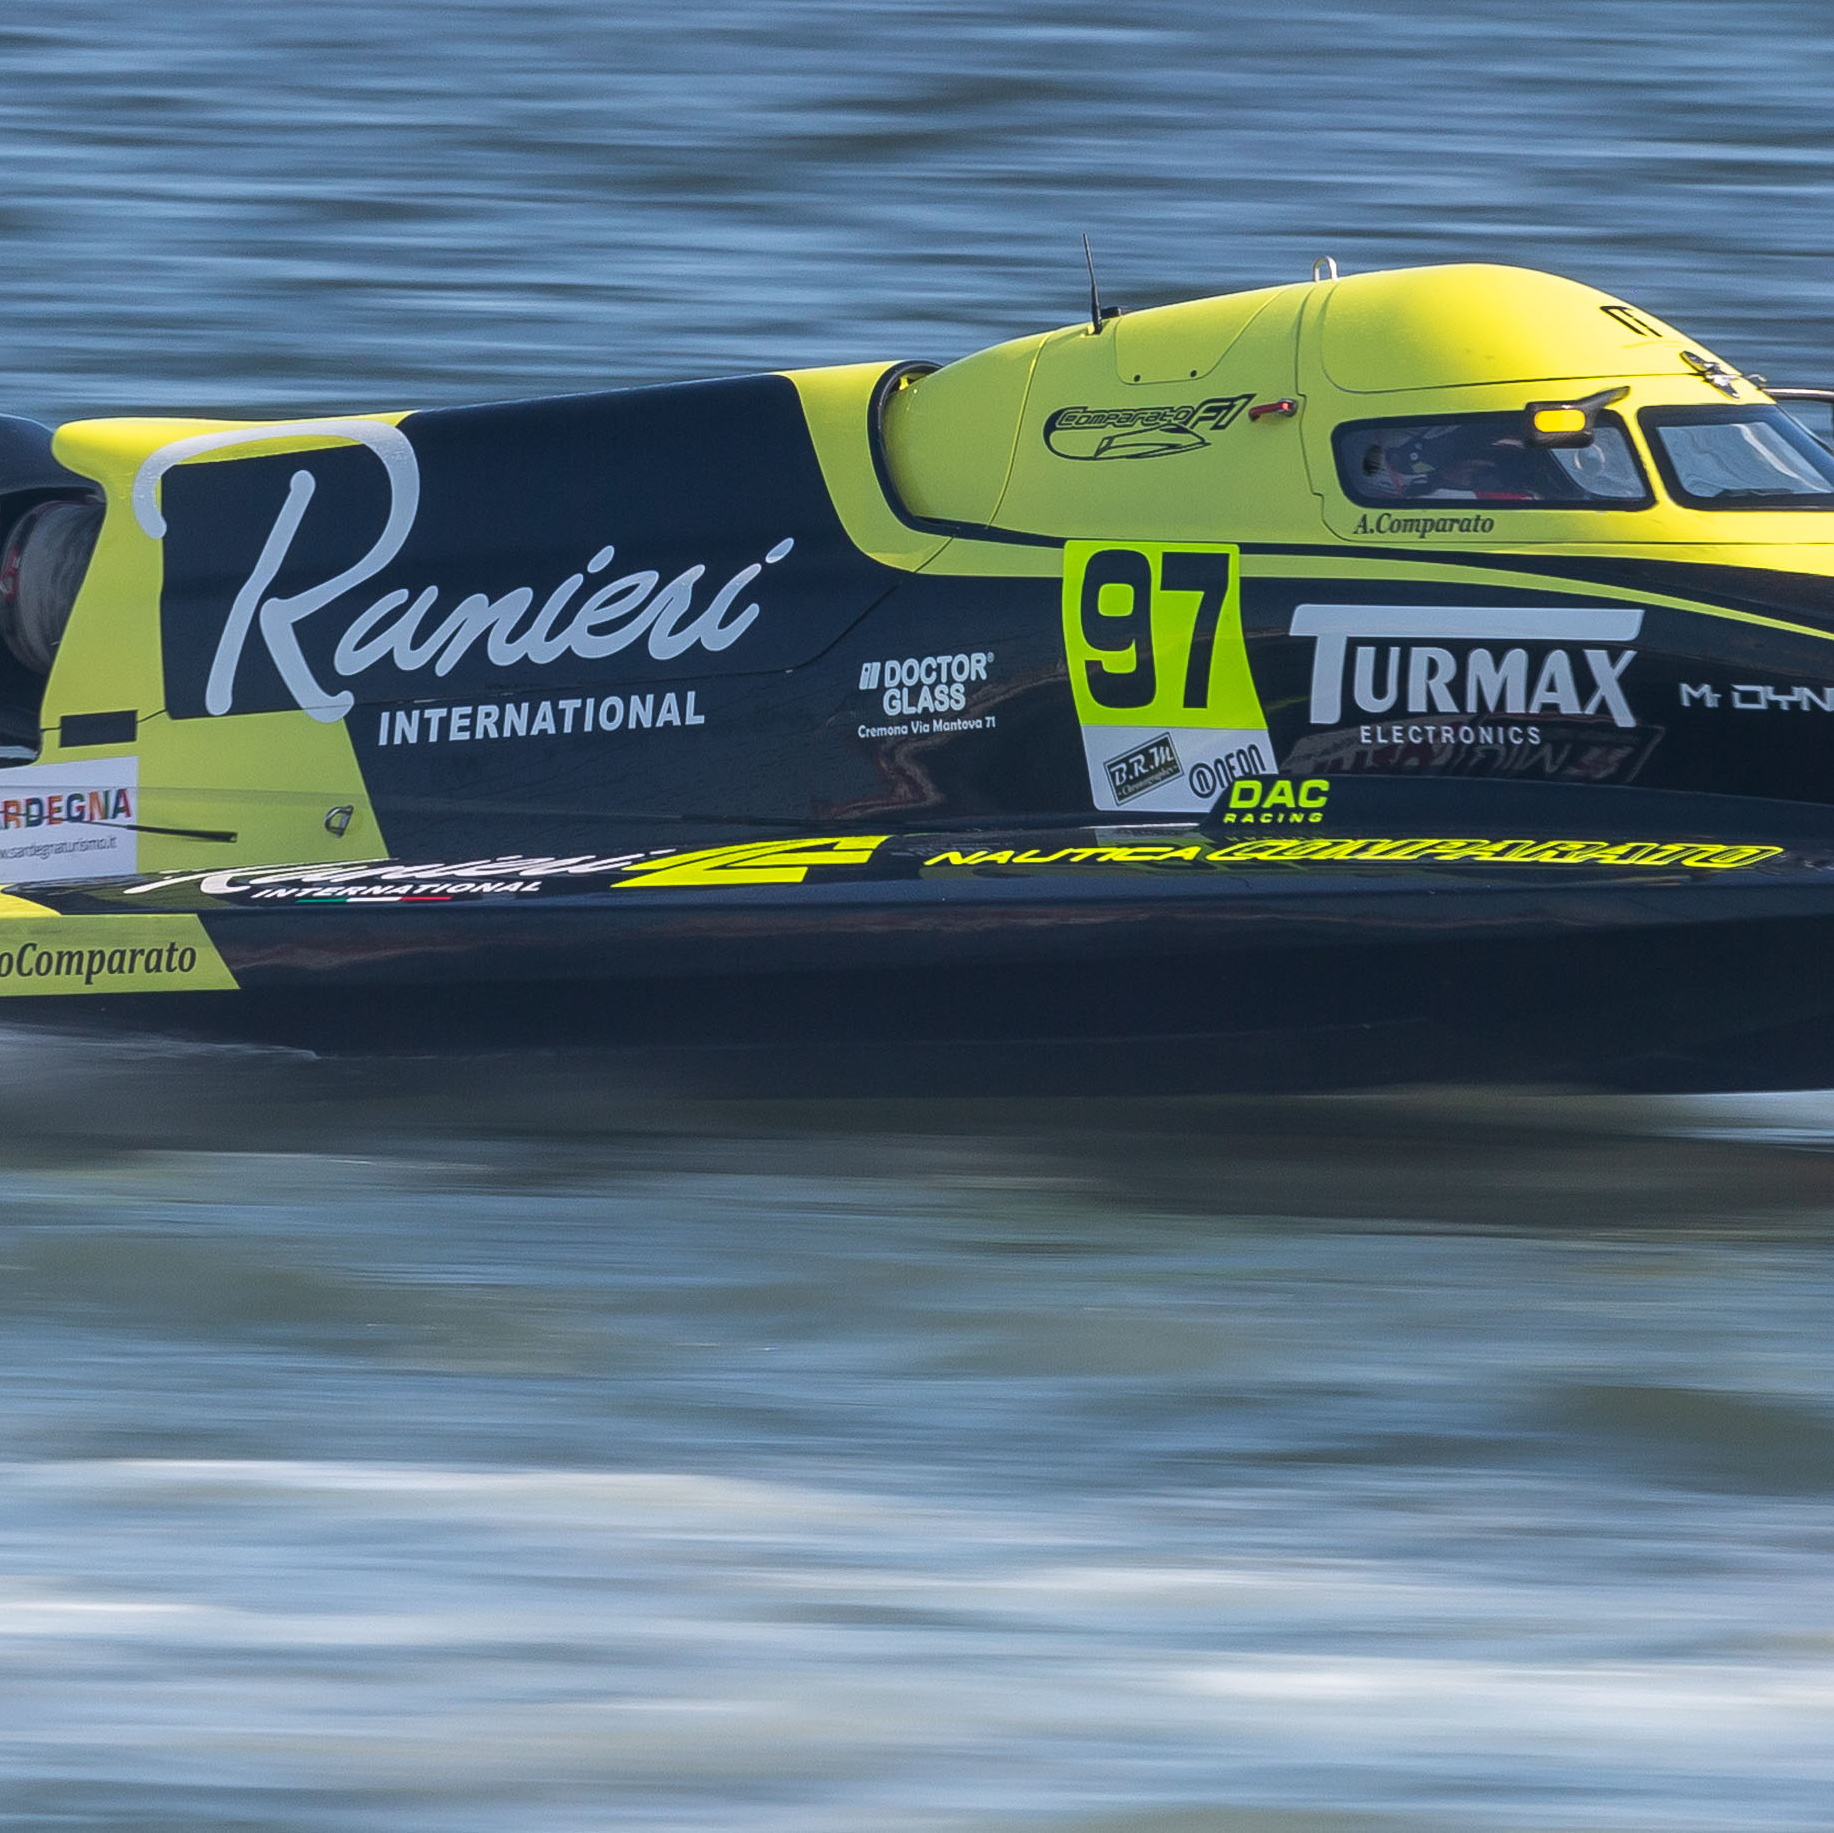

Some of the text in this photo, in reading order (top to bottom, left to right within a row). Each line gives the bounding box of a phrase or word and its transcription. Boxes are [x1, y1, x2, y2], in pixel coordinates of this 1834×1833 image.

[1352, 512, 1495, 539] A.Comparato
[131, 419, 794, 723] Ranieri
[1079, 548, 1231, 709] 97
[1288, 603, 1645, 728] TURMAX
[882, 682, 966, 716] GLASS
[377, 690, 706, 746] INTERNATIONAL
[857, 715, 996, 739] Cremona Via Mantova 71
[1359, 725, 1543, 745] ELECTRONICS
[1229, 778, 1330, 809] DAC
[1223, 811, 1324, 824] RACING
[923, 838, 1784, 869] NAUTICA COMPARATO
[251, 881, 542, 899] INTERNATIONAL
